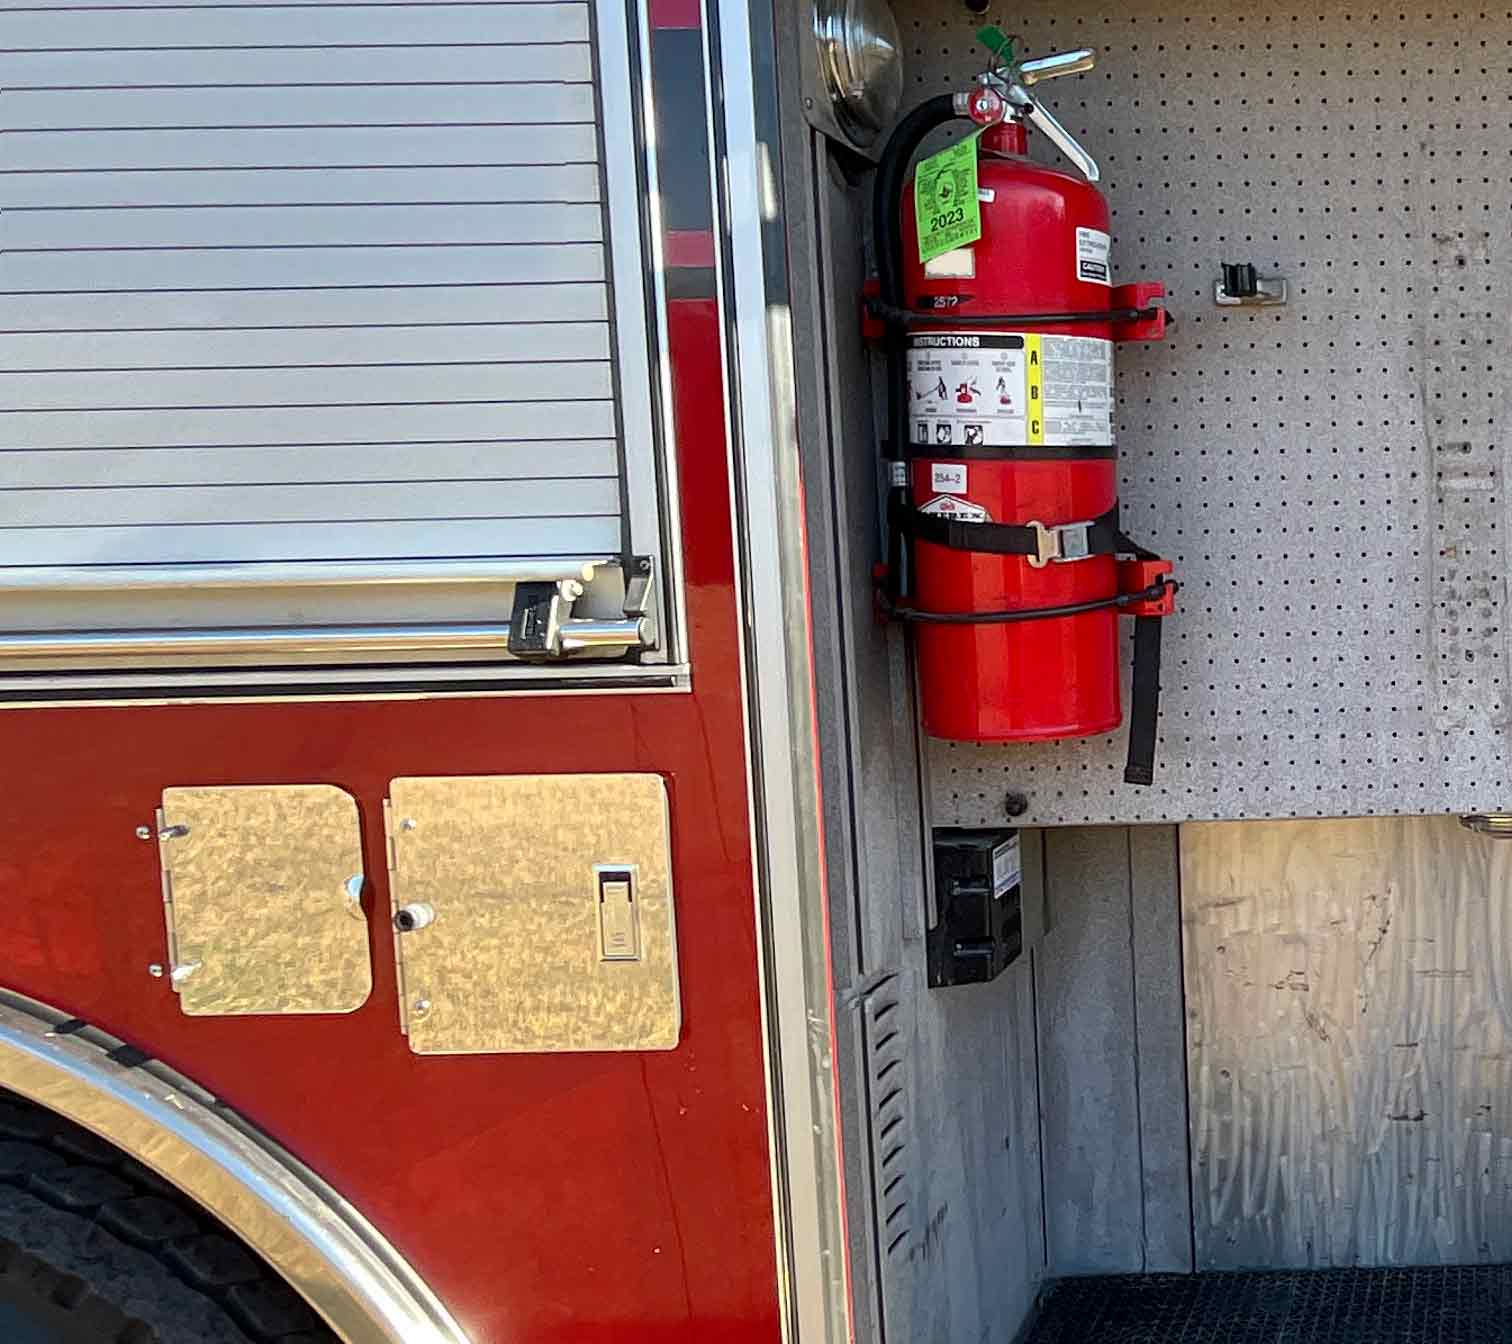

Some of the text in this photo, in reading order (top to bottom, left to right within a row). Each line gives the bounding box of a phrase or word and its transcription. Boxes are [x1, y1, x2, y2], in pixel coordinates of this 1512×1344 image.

[930, 207, 964, 233] 2023
[1031, 350, 1038, 365] A
[1031, 385, 1039, 400] B
[1032, 420, 1040, 434] C
